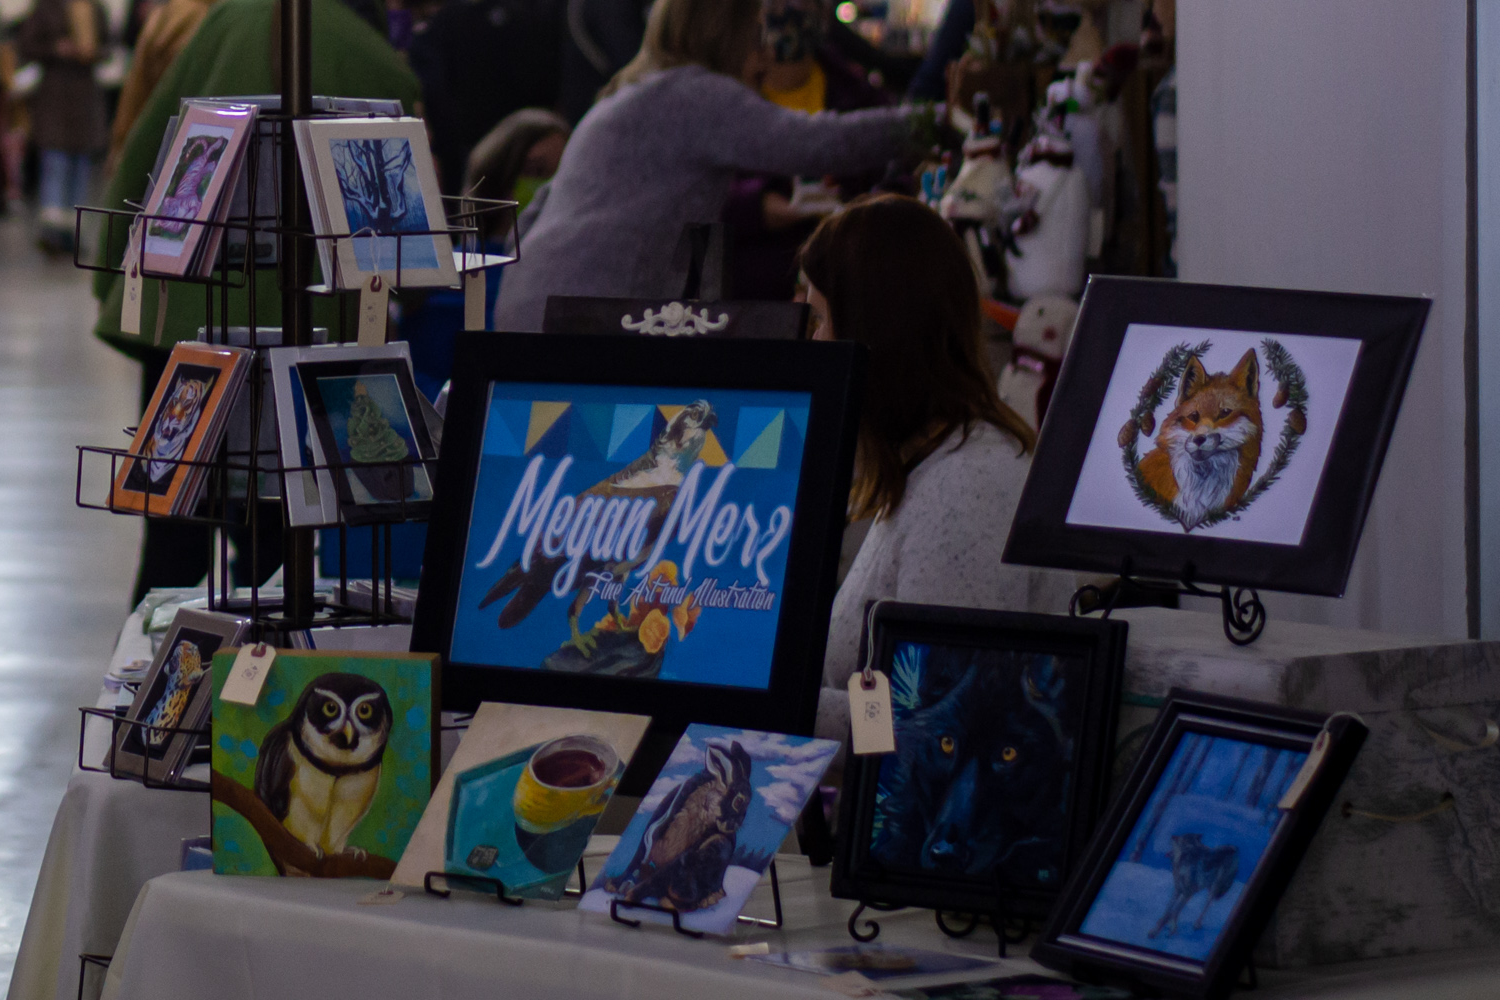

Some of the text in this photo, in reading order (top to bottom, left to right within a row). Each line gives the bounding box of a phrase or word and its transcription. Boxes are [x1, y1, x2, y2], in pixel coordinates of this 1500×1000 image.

[475, 454, 791, 598] Megan Merz
[585, 571, 776, 610] Fine Art and Illustration
